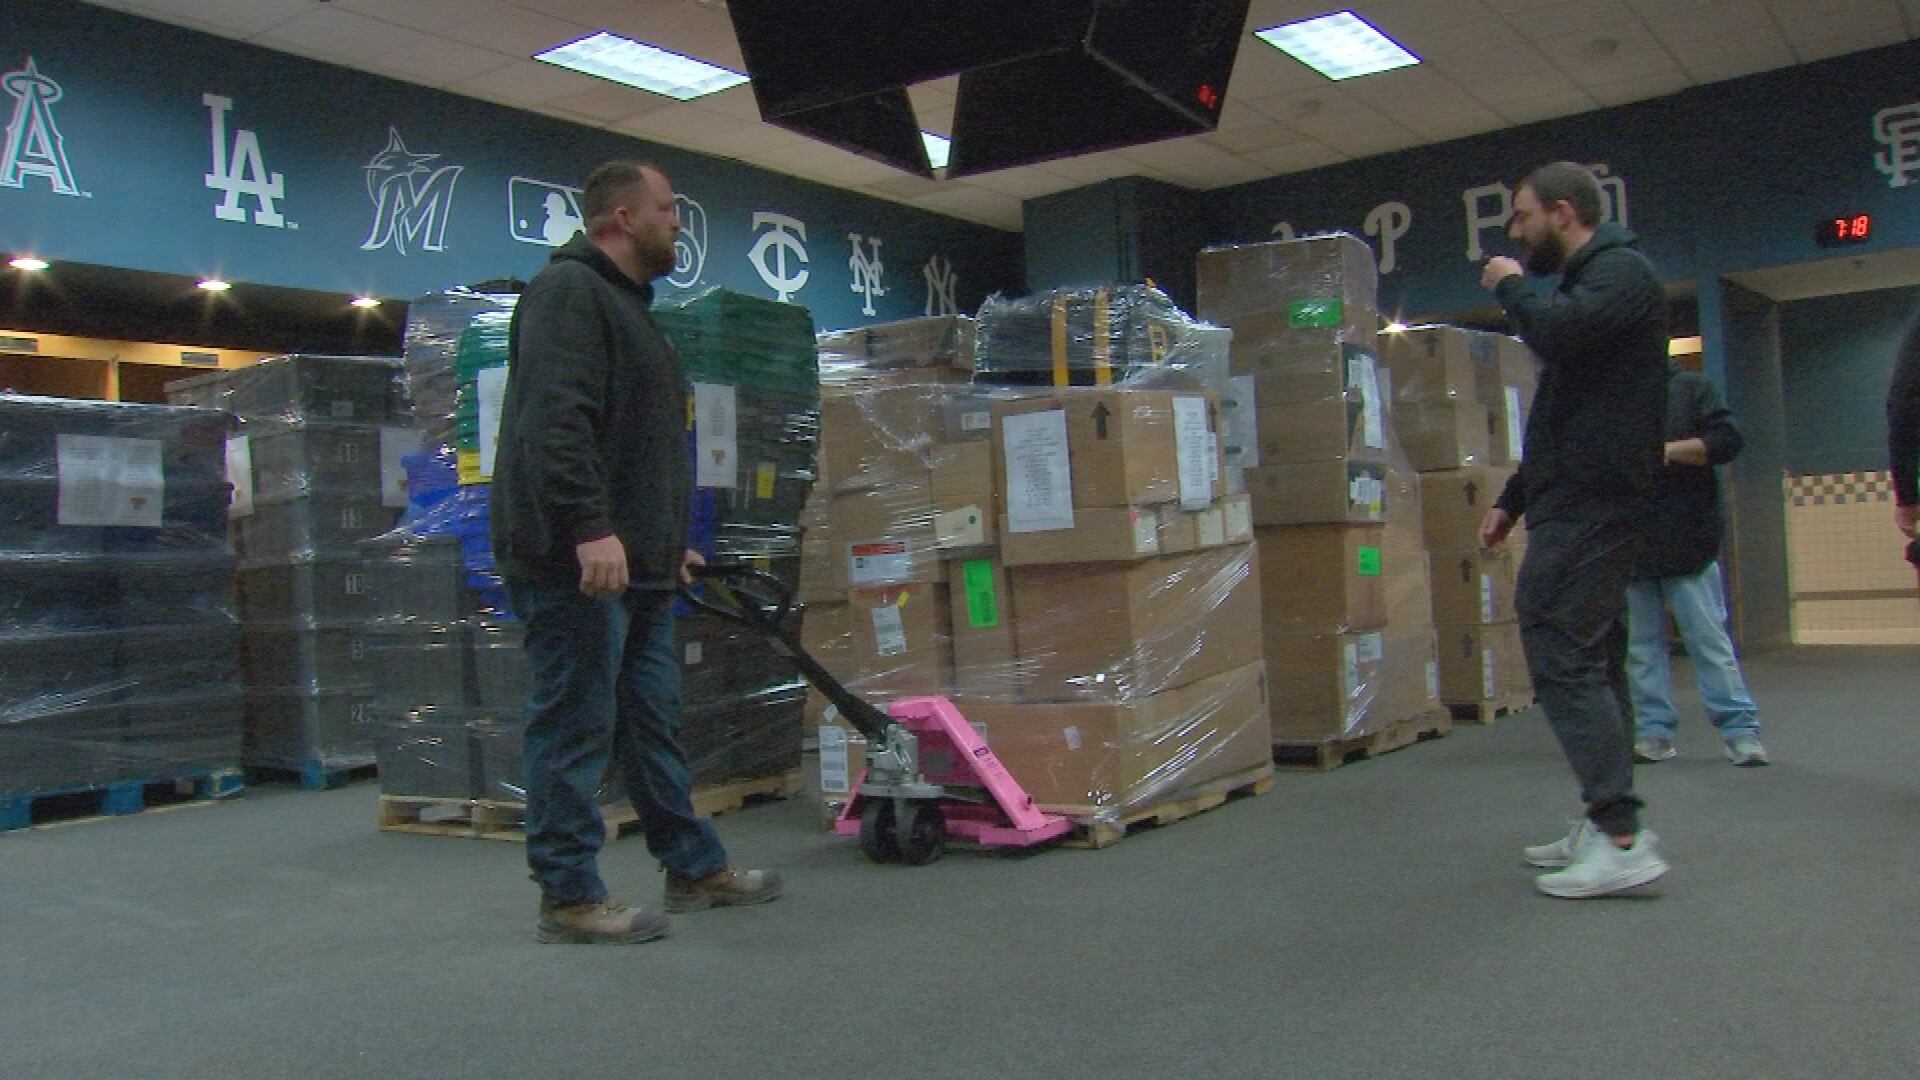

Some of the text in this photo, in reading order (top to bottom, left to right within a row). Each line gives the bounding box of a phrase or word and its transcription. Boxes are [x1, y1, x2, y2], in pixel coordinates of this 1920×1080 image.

[0, 55, 80, 197] A
[202, 93, 285, 229] LA
[360, 160, 464, 254] M
[1363, 201, 1413, 275] P
[1835, 214, 1872, 237] 7:18
